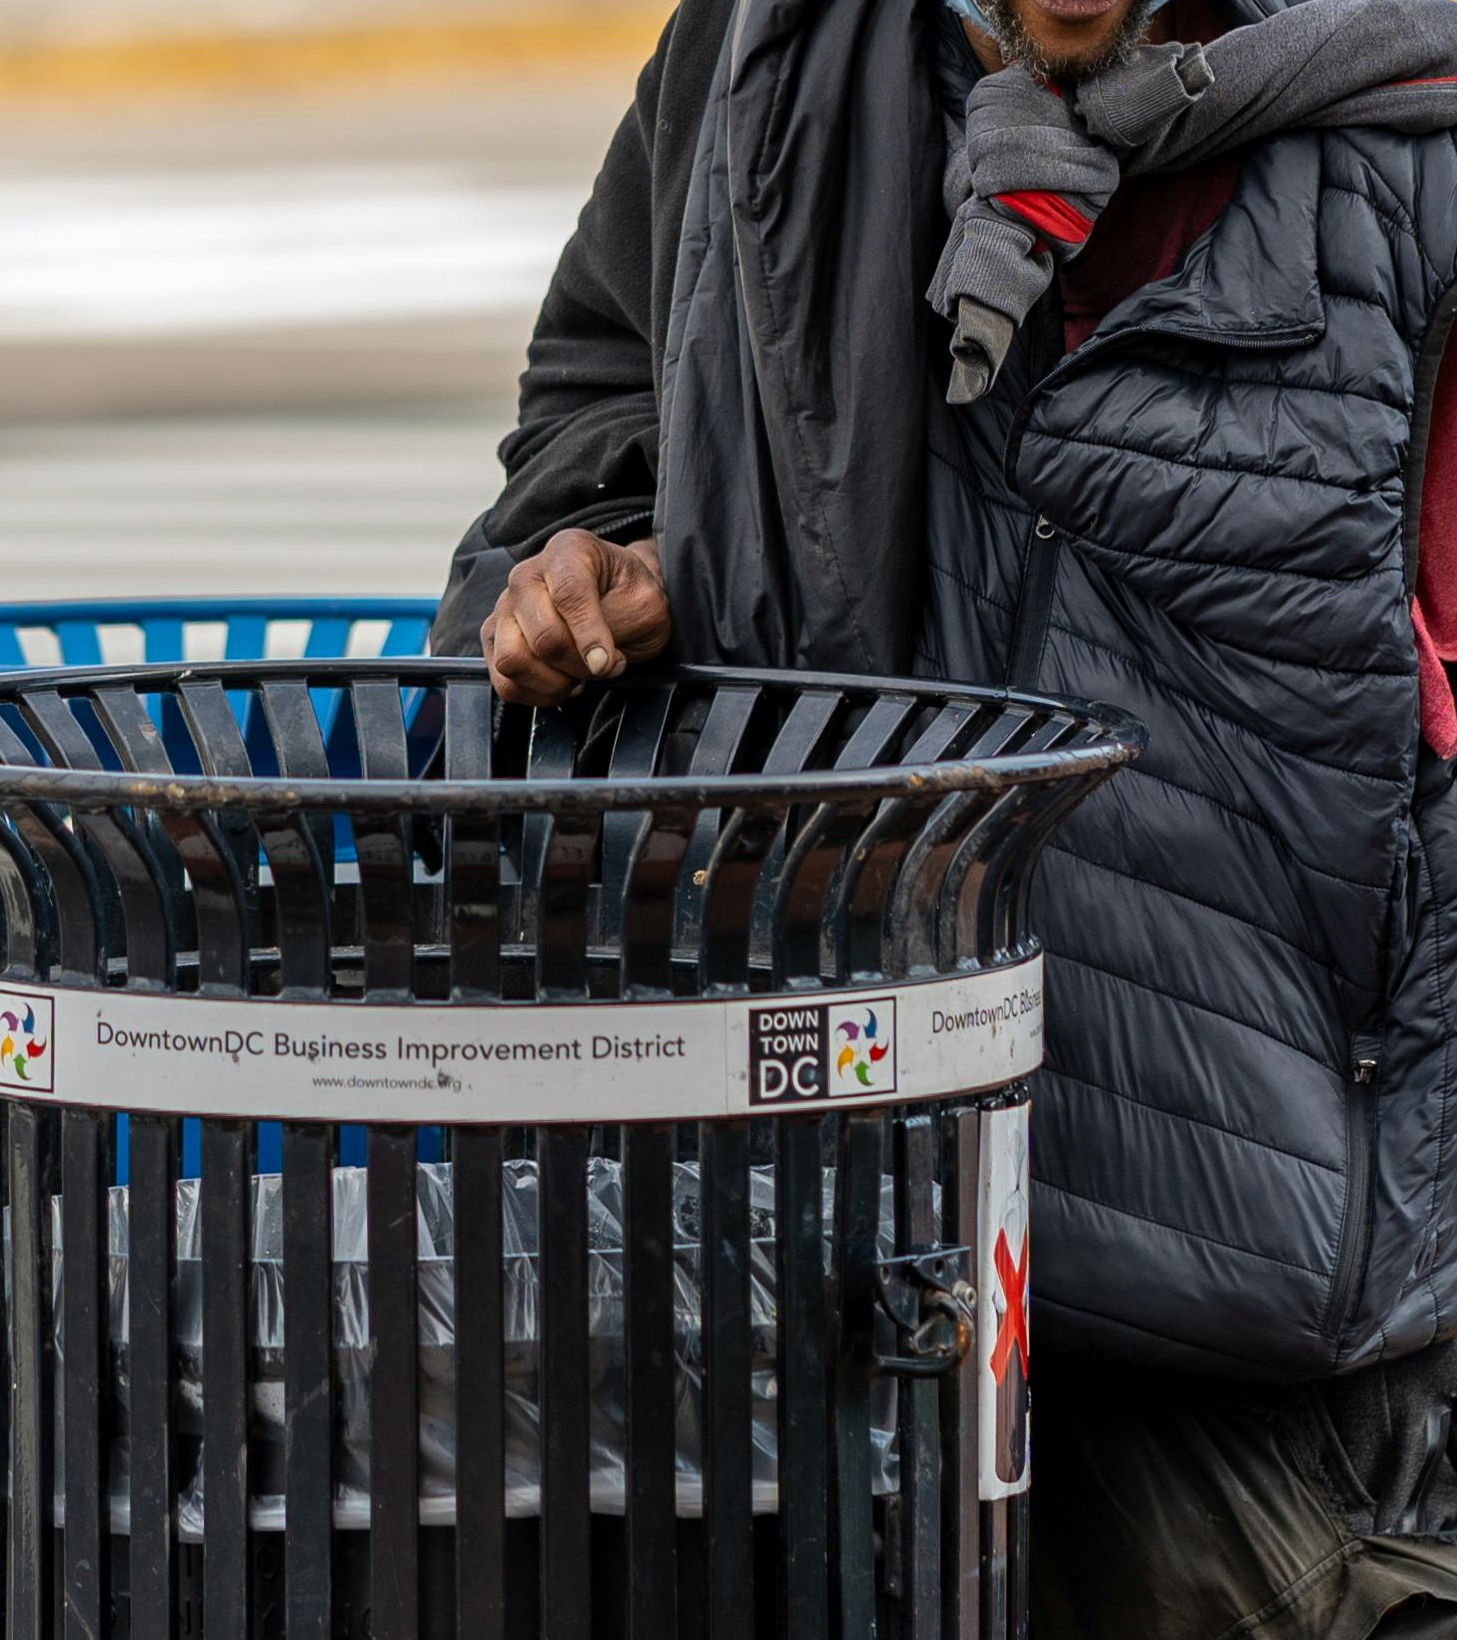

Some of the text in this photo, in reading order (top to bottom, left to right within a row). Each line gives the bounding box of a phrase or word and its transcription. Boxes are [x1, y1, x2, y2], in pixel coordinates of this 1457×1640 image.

[759, 1009, 819, 1032] DOWN
[932, 993, 1018, 1034] DowntownDC
[96, 1021, 686, 1069] DowntownDC Business Improvement District
[759, 1033, 819, 1055] TOWN
[759, 1056, 820, 1099] DC
